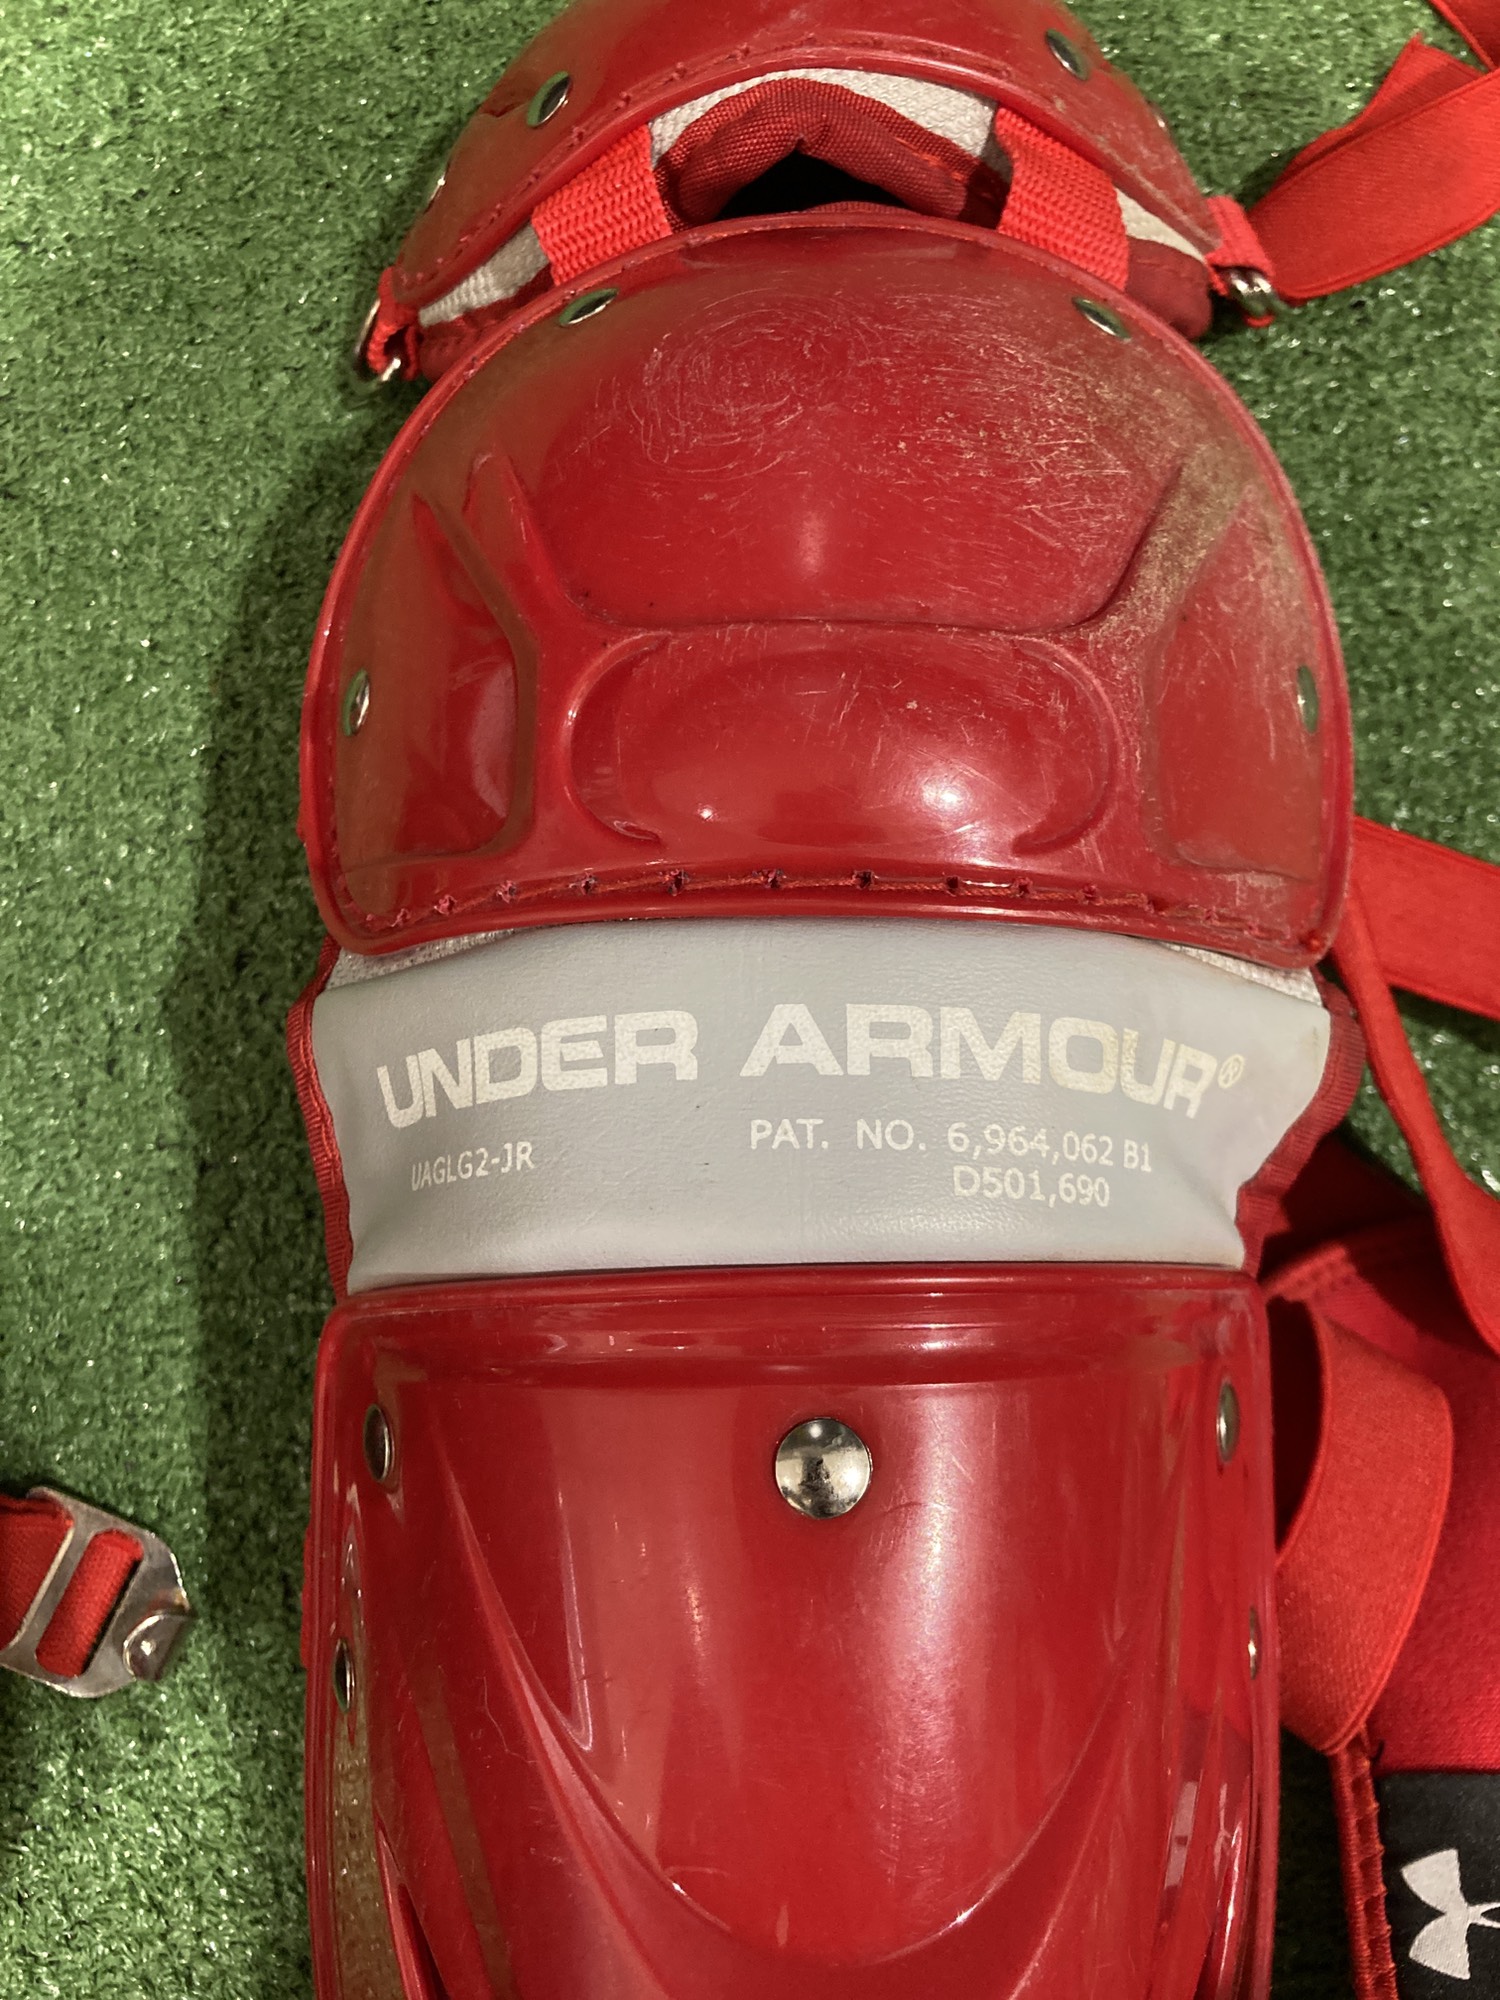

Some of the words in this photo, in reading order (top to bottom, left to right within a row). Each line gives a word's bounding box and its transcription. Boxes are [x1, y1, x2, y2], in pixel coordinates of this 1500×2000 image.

[376, 1009, 699, 1128] UNDER
[410, 1141, 536, 1192] UAGLG2-JR
[749, 1118, 829, 1150] PAT.
[856, 1119, 926, 1151] NO.
[946, 1121, 1114, 1167] 6,964,062
[1122, 1140, 1153, 1173] B1
[952, 1164, 1110, 1208] D501,690
